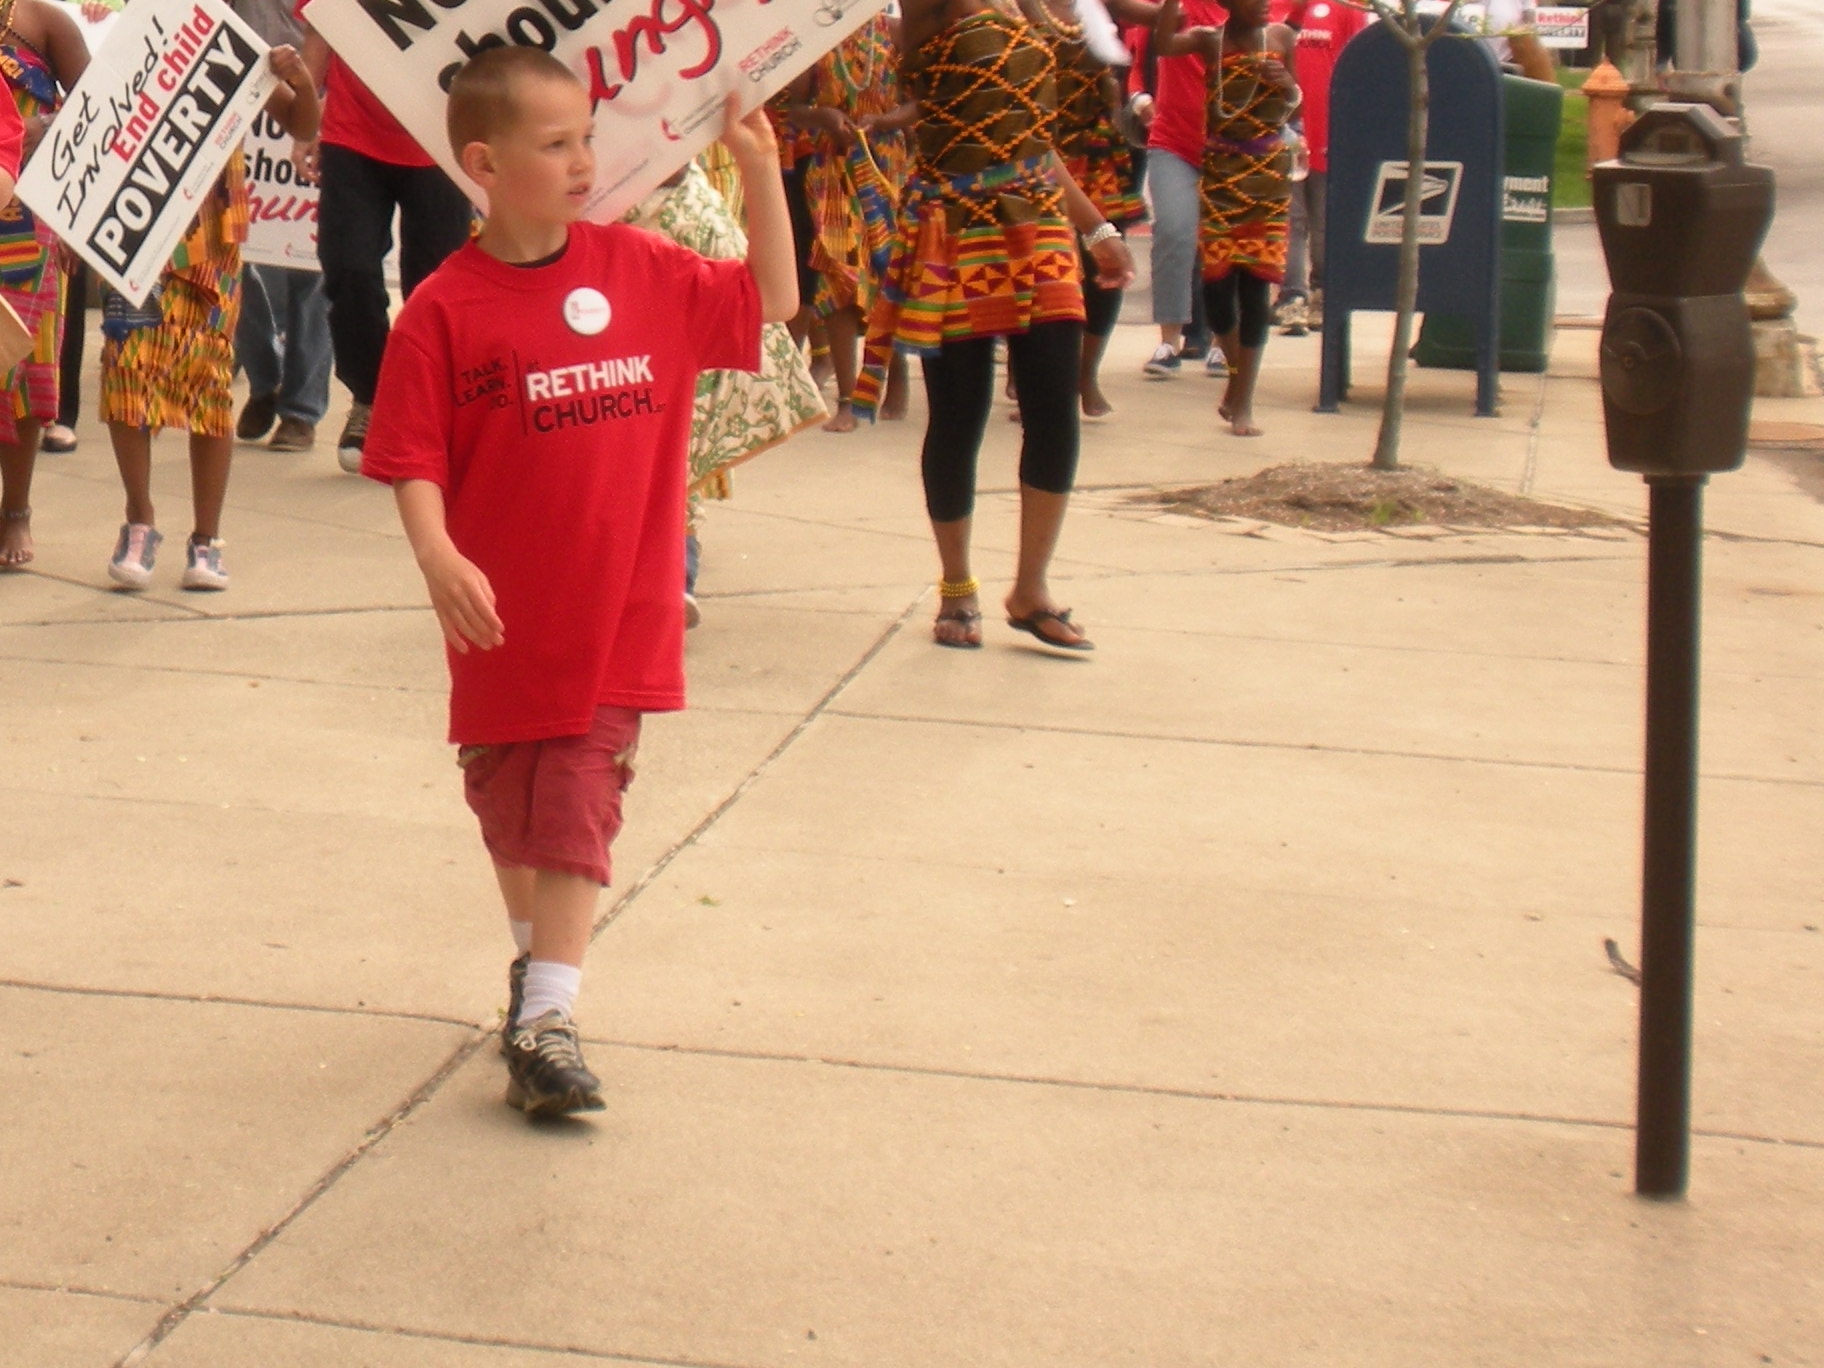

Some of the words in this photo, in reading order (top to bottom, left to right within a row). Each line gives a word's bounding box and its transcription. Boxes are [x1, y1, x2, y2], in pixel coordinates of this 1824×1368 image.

[51, 91, 100, 182] Get
[110, 92, 161, 164] End
[156, 3, 215, 92] child
[93, 39, 249, 268] POVERTY
[525, 354, 655, 403] RETHINK
